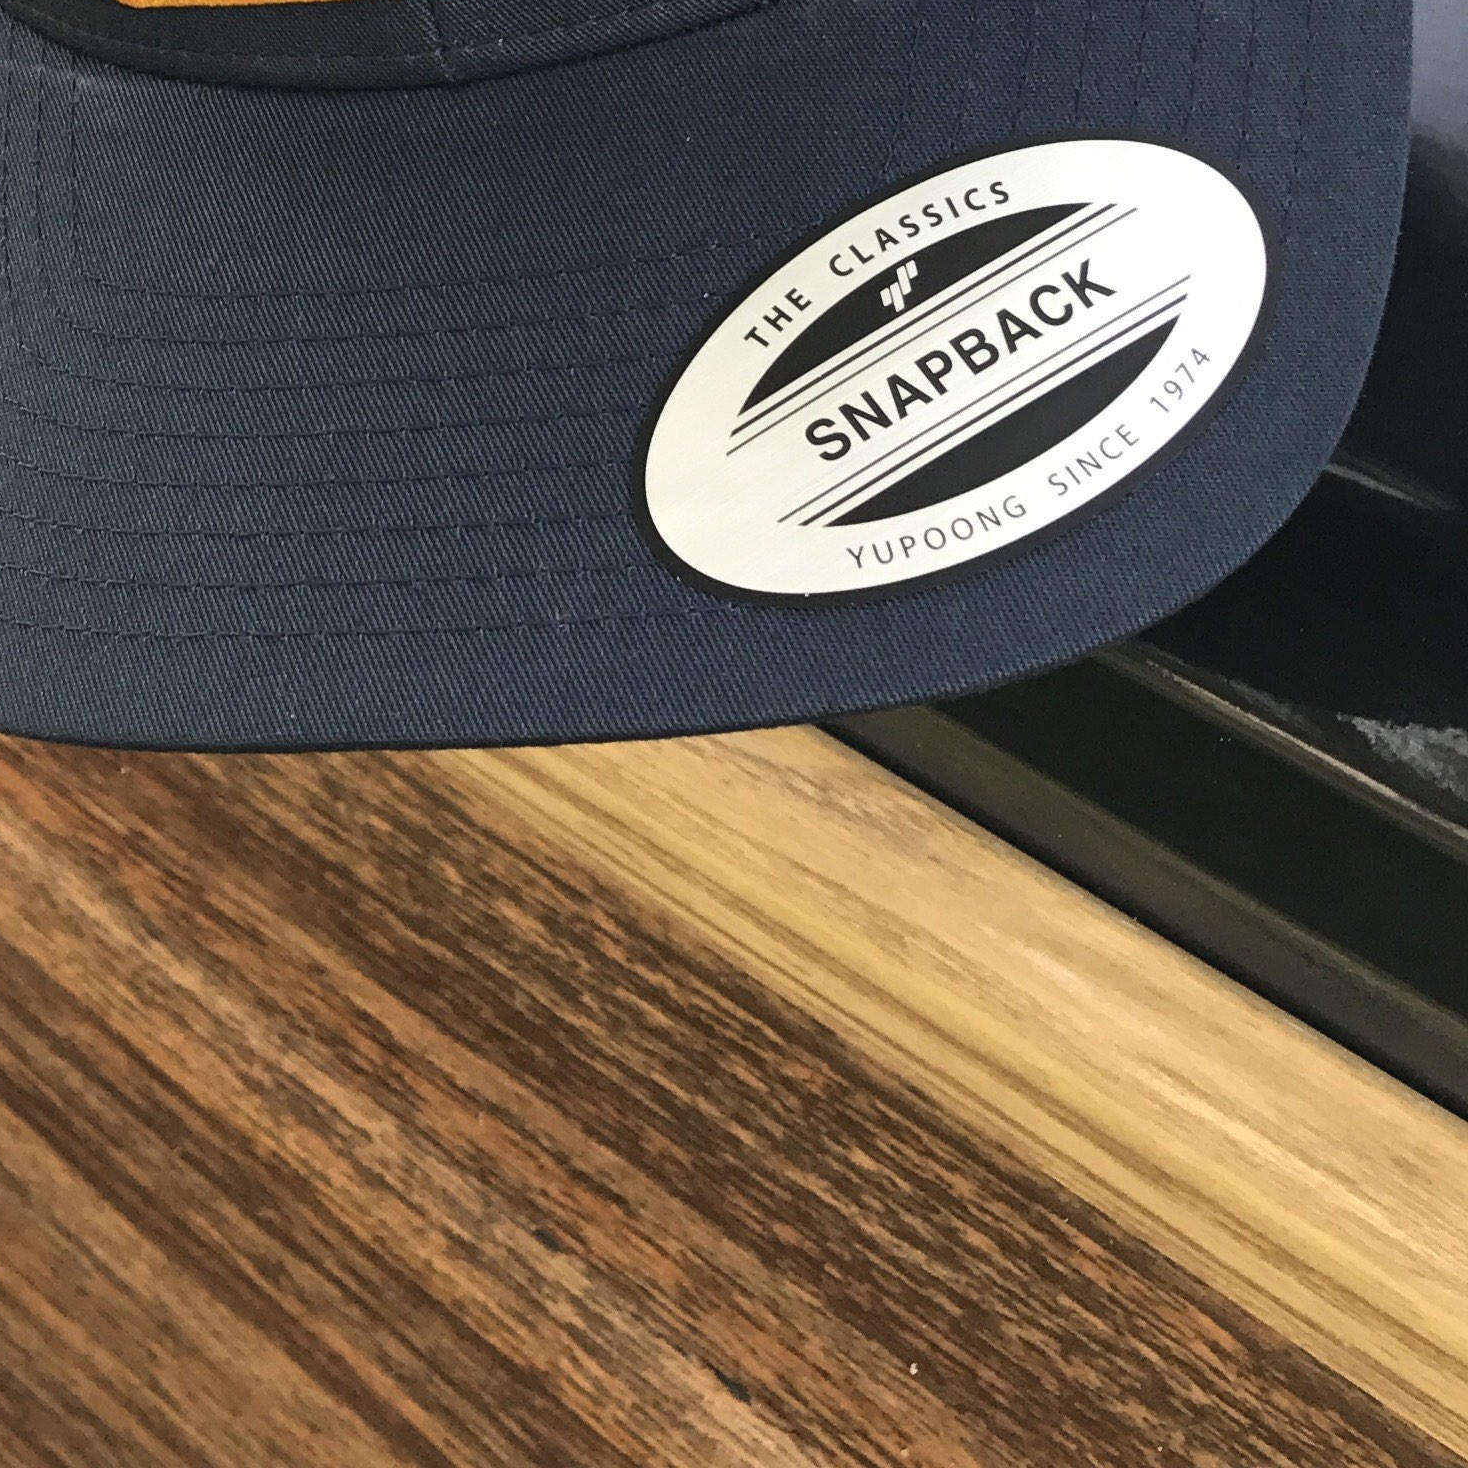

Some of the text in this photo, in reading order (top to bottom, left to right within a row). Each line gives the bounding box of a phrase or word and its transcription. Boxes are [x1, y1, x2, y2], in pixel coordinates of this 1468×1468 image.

[744, 180, 1011, 348] THE CLASSICS
[804, 258, 1117, 461] SNAPBACK
[846, 346, 1213, 570] YUPOONG SINCE 1974
